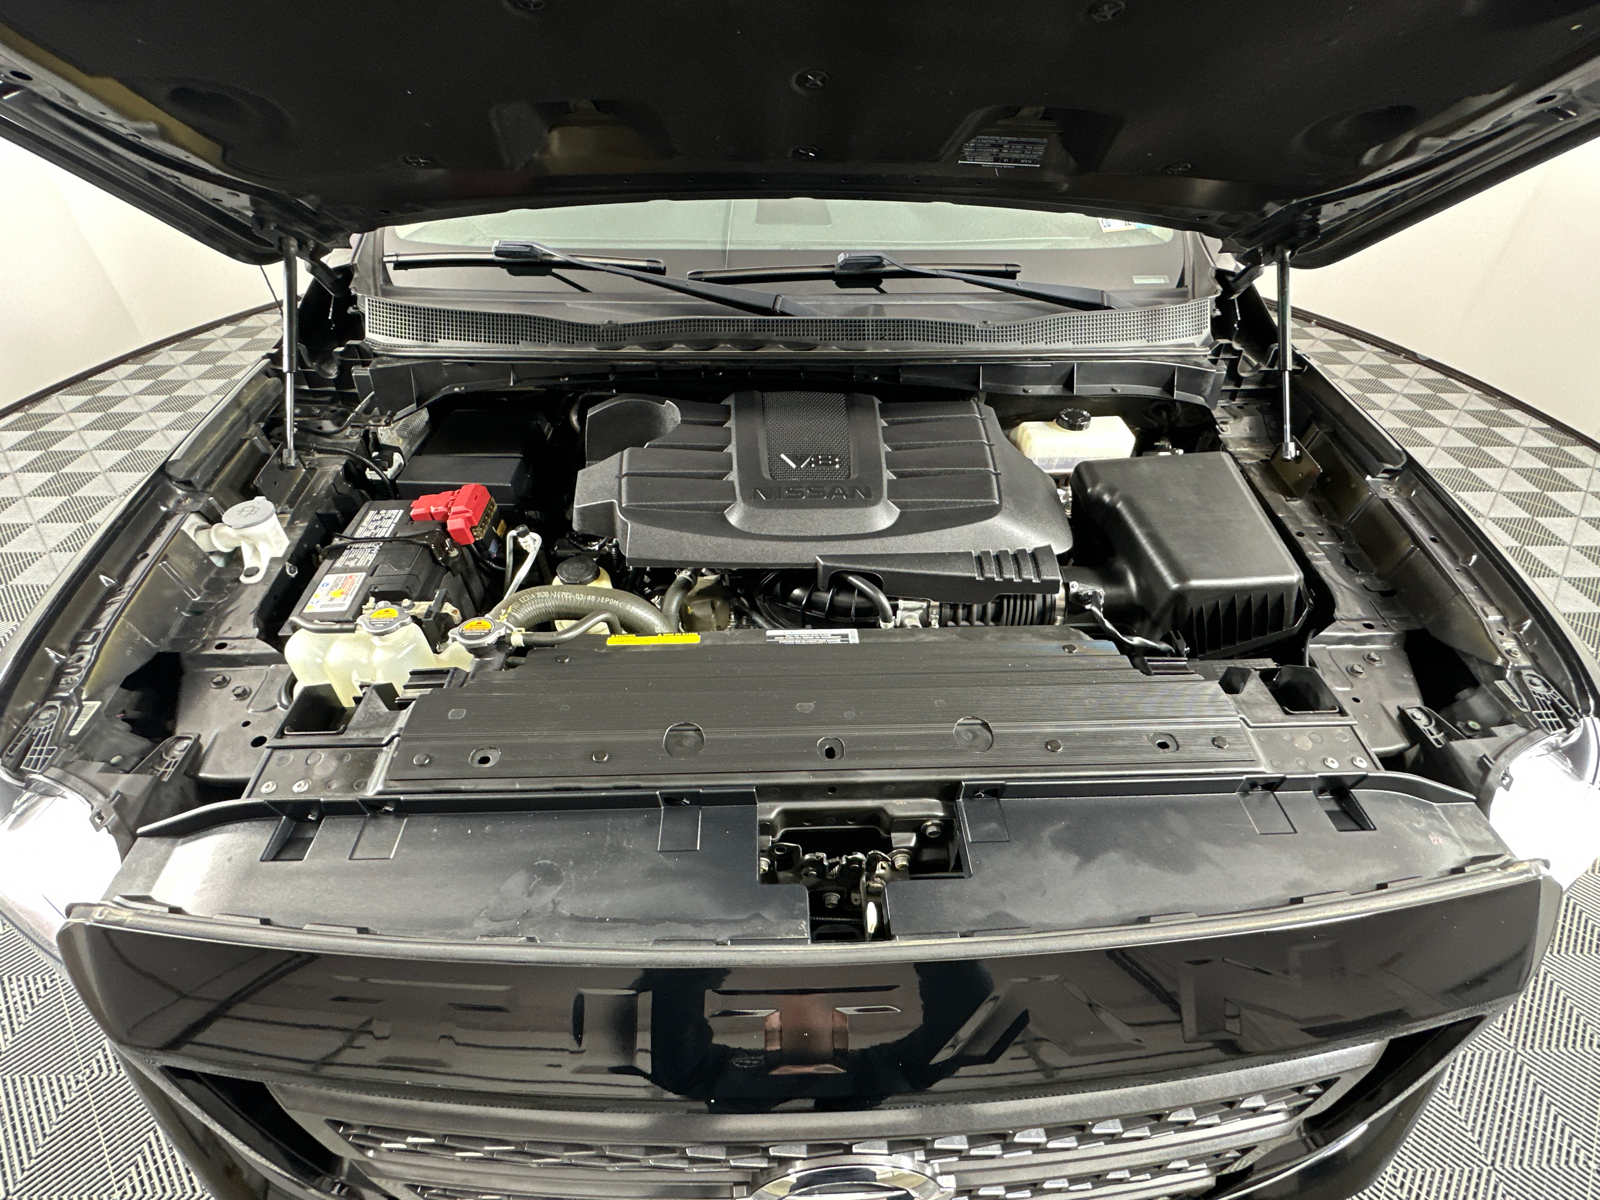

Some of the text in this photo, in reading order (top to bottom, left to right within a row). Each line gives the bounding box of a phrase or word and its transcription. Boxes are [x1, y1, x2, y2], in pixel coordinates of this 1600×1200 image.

[780, 453, 840, 468] V8
[751, 485, 874, 502] NISSAN
[326, 941, 1412, 1076] TITAN
